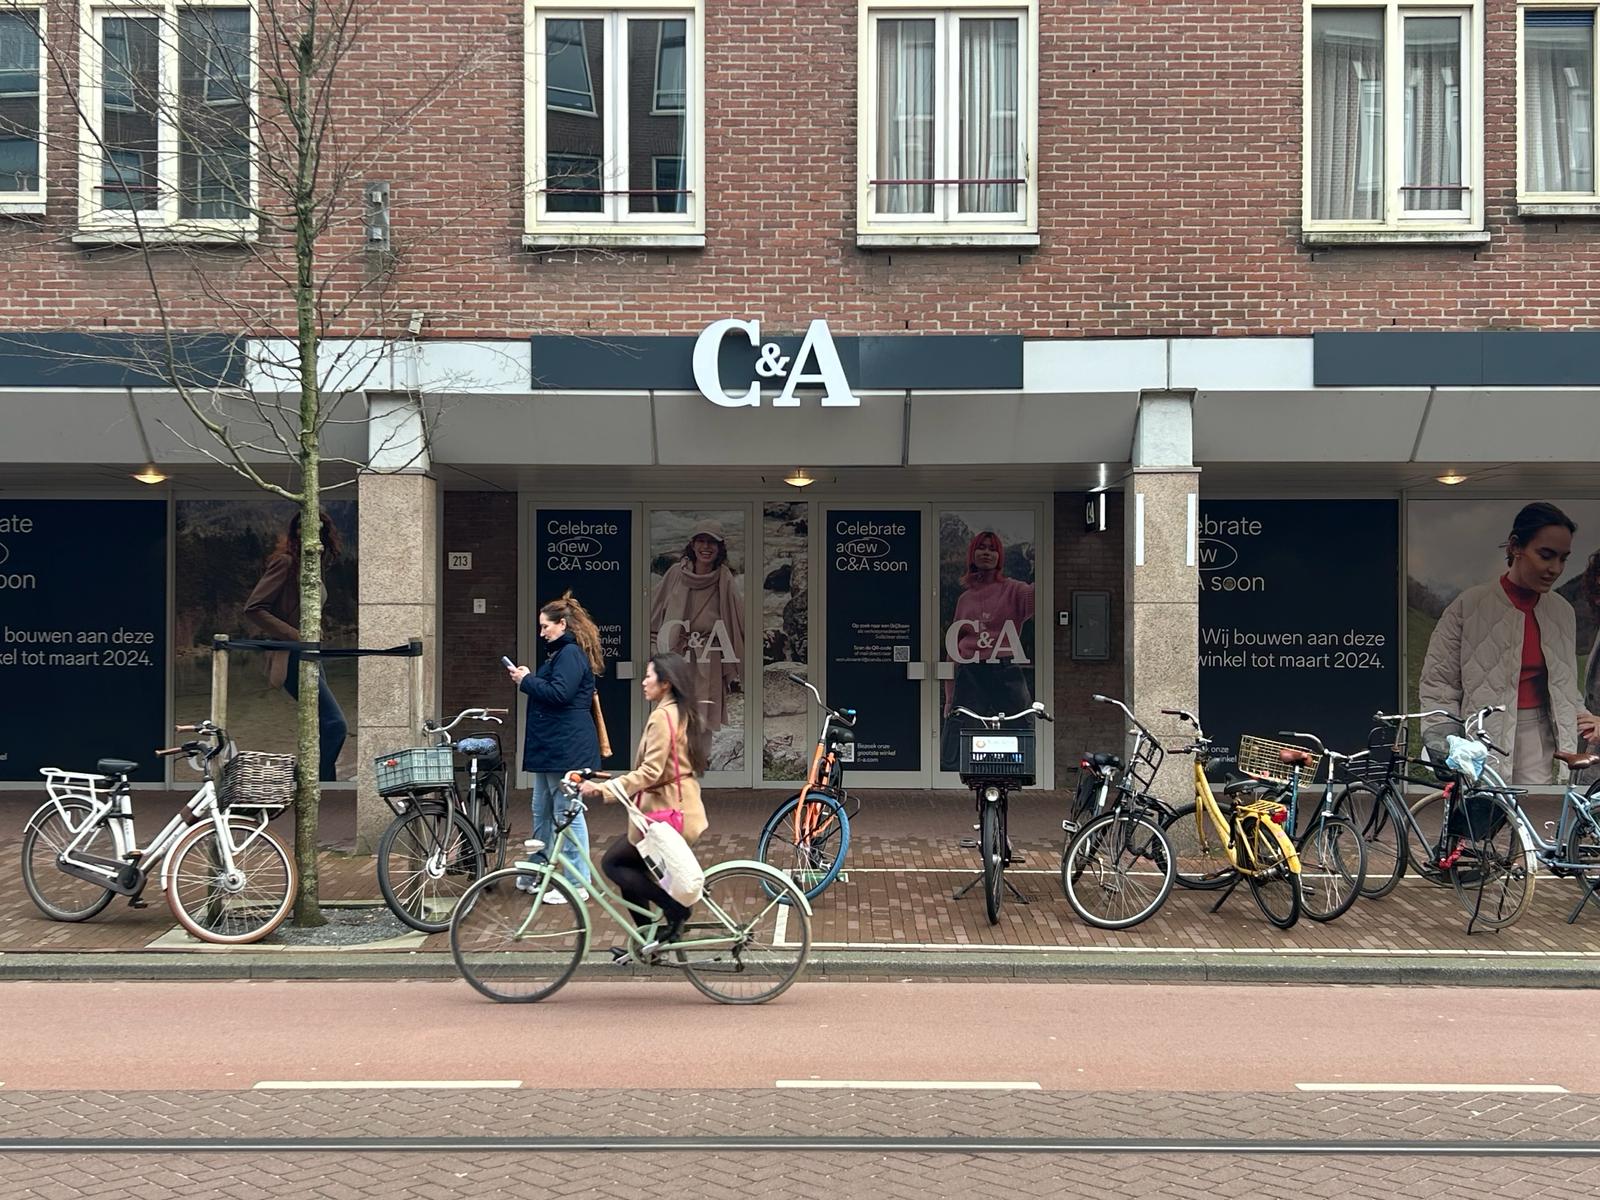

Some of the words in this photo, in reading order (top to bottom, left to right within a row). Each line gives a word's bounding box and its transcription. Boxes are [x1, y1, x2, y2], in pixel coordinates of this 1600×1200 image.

[692, 318, 861, 408] C&A
[547, 520, 618, 535] Celebrate
[836, 520, 906, 536] Celebrate
[452, 555, 468, 567] 213
[547, 556, 582, 571] C&A
[584, 559, 620, 571] soon
[836, 556, 870, 572] C&A
[873, 559, 908, 572] soon
[1211, 576, 1265, 592] soon
[4, 626, 73, 644] bouwen
[76, 631, 107, 644] aan
[111, 628, 154, 644] deze
[656, 619, 741, 664] C&A
[944, 619, 1031, 665] C&A
[1202, 628, 1230, 648] Wij
[1234, 628, 1303, 646] bouwen
[1307, 633, 1339, 646] aan
[1343, 630, 1385, 646] deze
[21, 650, 46, 665] tot
[49, 651, 100, 666] maart
[103, 650, 154, 666] 2024.
[1250, 653, 1276, 668] tot
[1279, 653, 1331, 668] maart
[1334, 652, 1385, 669] 2024.
[1210, 746, 1230, 754] onze
